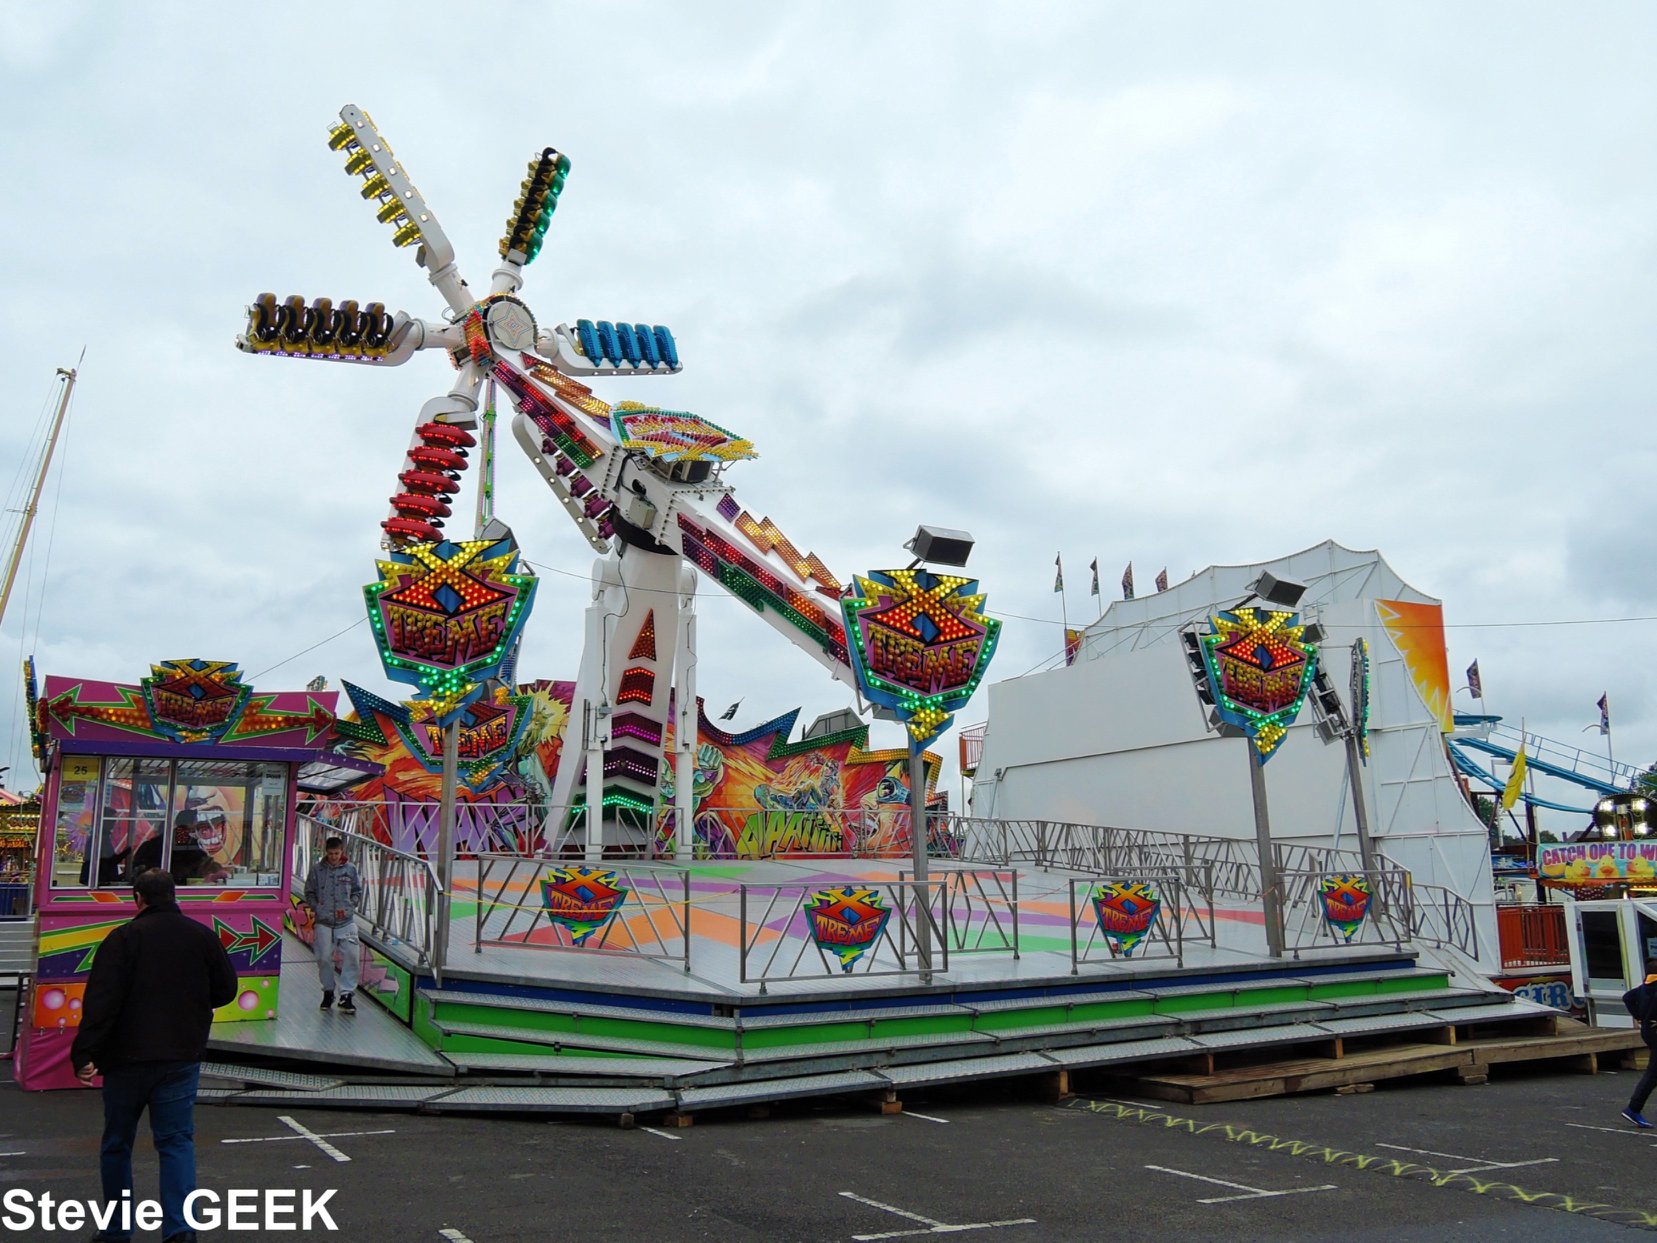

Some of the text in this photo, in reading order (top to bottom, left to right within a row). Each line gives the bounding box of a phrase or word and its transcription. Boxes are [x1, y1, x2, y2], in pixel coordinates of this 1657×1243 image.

[425, 715, 507, 758] TEME
[74, 766, 88, 775] 25
[1542, 845, 1586, 866] CATCH
[1589, 843, 1615, 862] ONE
[1618, 843, 1637, 860] TO
[816, 915, 880, 945] TREME
[1102, 906, 1152, 933] TREME
